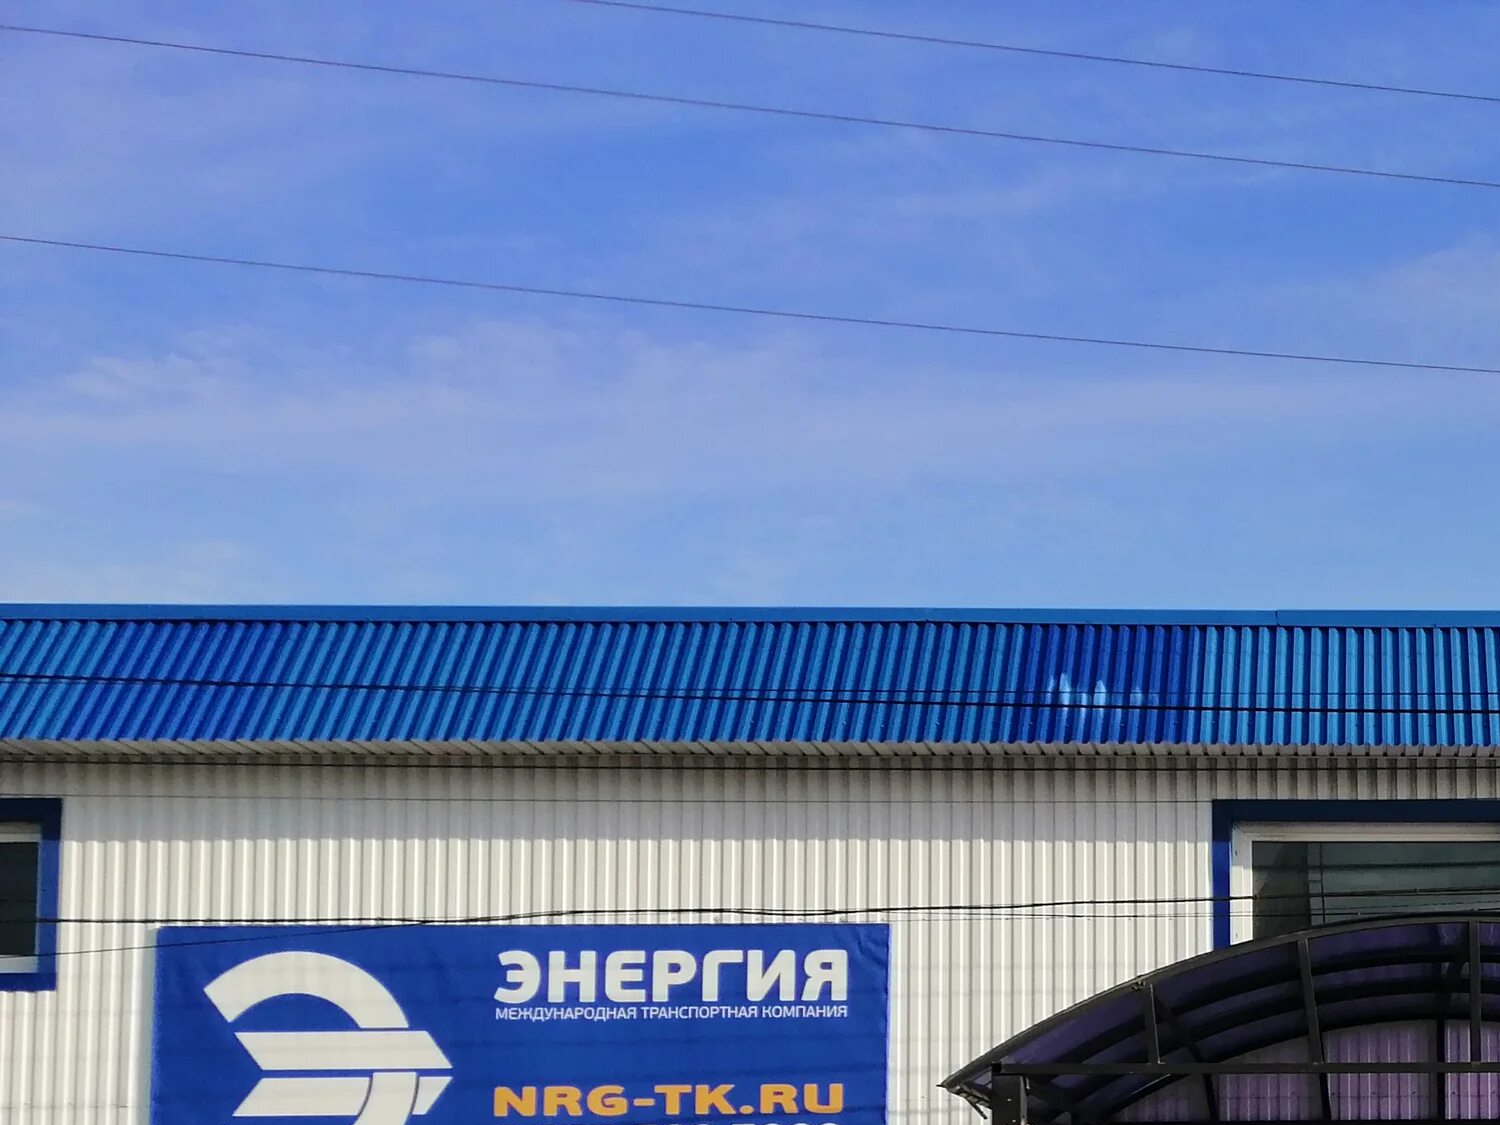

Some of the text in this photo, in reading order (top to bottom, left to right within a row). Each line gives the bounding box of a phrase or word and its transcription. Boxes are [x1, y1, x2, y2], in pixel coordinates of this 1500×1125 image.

[493, 949, 848, 1004] ЭНЕРГИЯ
[495, 1005, 848, 1022] МЕЖДУНАРОДНАЯ ТРАНСПОРТНАЯ КОМПАНИЯ
[493, 1083, 844, 1117] NRG-TK.RU
